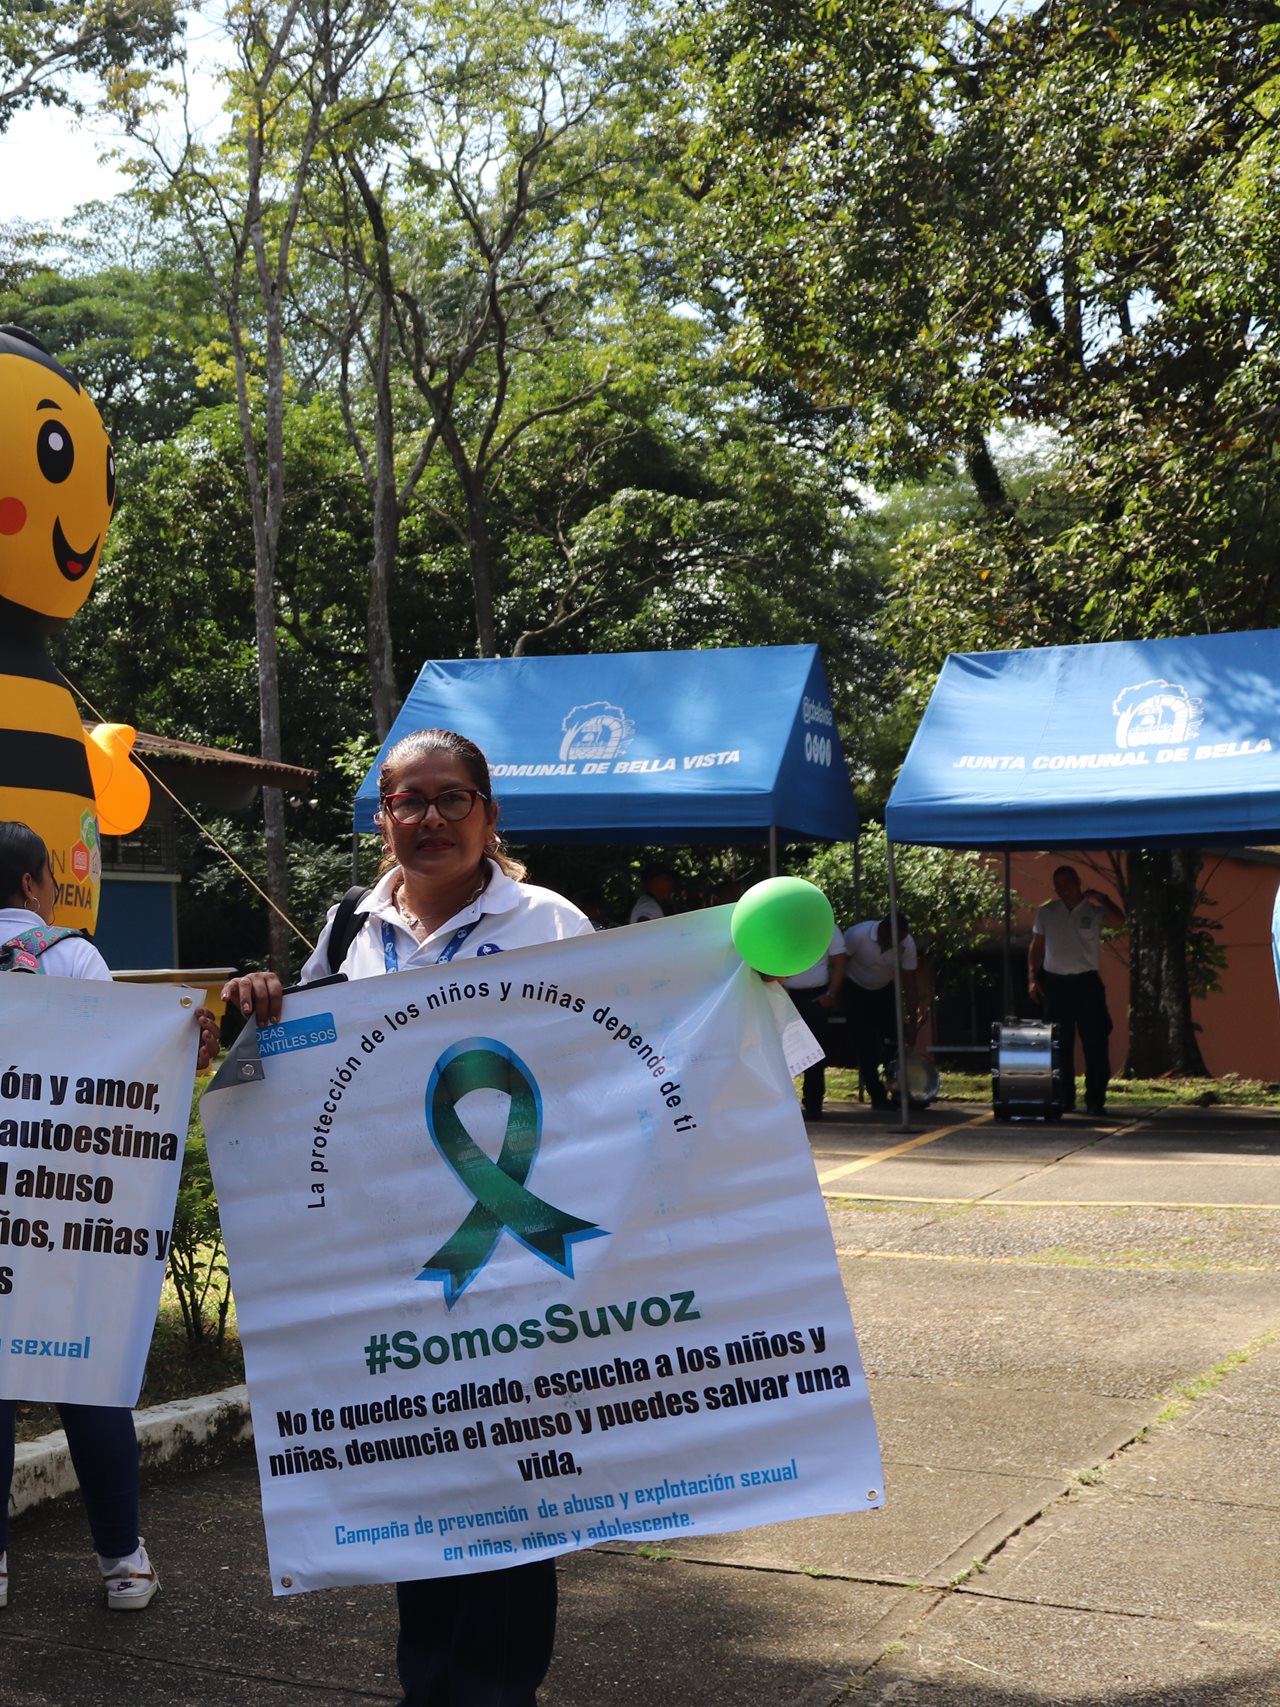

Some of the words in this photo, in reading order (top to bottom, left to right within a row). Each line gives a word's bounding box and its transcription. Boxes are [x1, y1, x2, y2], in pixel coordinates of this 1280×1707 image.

[581, 761, 608, 775] DE
[613, 757, 676, 774] BELLA
[683, 750, 740, 771] VISTA
[953, 755, 1026, 770] JUNTA
[1032, 751, 1150, 770] COMUNAL
[1155, 748, 1189, 764] DE
[1194, 738, 1272, 761] BELLA
[426, 982, 490, 1010] niños
[499, 981, 512, 1001] y
[522, 981, 586, 1014] niñas
[384, 1003, 420, 1031] los
[256, 1026, 285, 1042] DEAS
[259, 1034, 307, 1054] ANTILES
[310, 1028, 336, 1043] SOS
[360, 1029, 385, 1054] de
[592, 1006, 666, 1078] depende
[50, 1074, 69, 1106] y
[75, 1075, 160, 1115] amor,
[660, 1081, 681, 1108] de
[310, 1056, 362, 1173] protección
[673, 1114, 697, 1133] ti
[0, 1117, 178, 1161] autoestima
[14, 1166, 114, 1205] abuso
[308, 1183, 326, 1209] La
[62, 1218, 149, 1257] niñas
[155, 1229, 170, 1262] y
[10, 1336, 91, 1360] sexual
[364, 1290, 701, 1375] #SomosSuvoz
[276, 1410, 307, 1438] No
[311, 1407, 335, 1433] te
[339, 1394, 428, 1431] quedes
[431, 1377, 531, 1415] callado,
[534, 1357, 651, 1399] escucha
[655, 1353, 674, 1378] a
[676, 1344, 721, 1375] los
[725, 1329, 806, 1366] niños
[808, 1326, 827, 1355] y
[268, 1445, 343, 1477] niñas,
[345, 1426, 459, 1467] denuncia
[462, 1421, 487, 1450] el
[490, 1411, 573, 1446] abuso
[575, 1408, 593, 1435] y
[597, 1391, 699, 1432] puedes
[703, 1372, 791, 1411] salvar
[795, 1363, 851, 1396] una
[517, 1449, 582, 1481] vida,
[335, 1520, 410, 1546] Campaña
[414, 1515, 434, 1536] de
[438, 1505, 529, 1537] prevención
[537, 1498, 558, 1519] de
[564, 1493, 615, 1515] abuso
[619, 1491, 629, 1510] y
[635, 1472, 736, 1505] explotación
[740, 1458, 798, 1487] sexual
[444, 1546, 464, 1561] en
[468, 1537, 518, 1559] niñas,
[521, 1530, 568, 1552] niños
[571, 1530, 581, 1546] y
[587, 1511, 695, 1540] adolescente.
